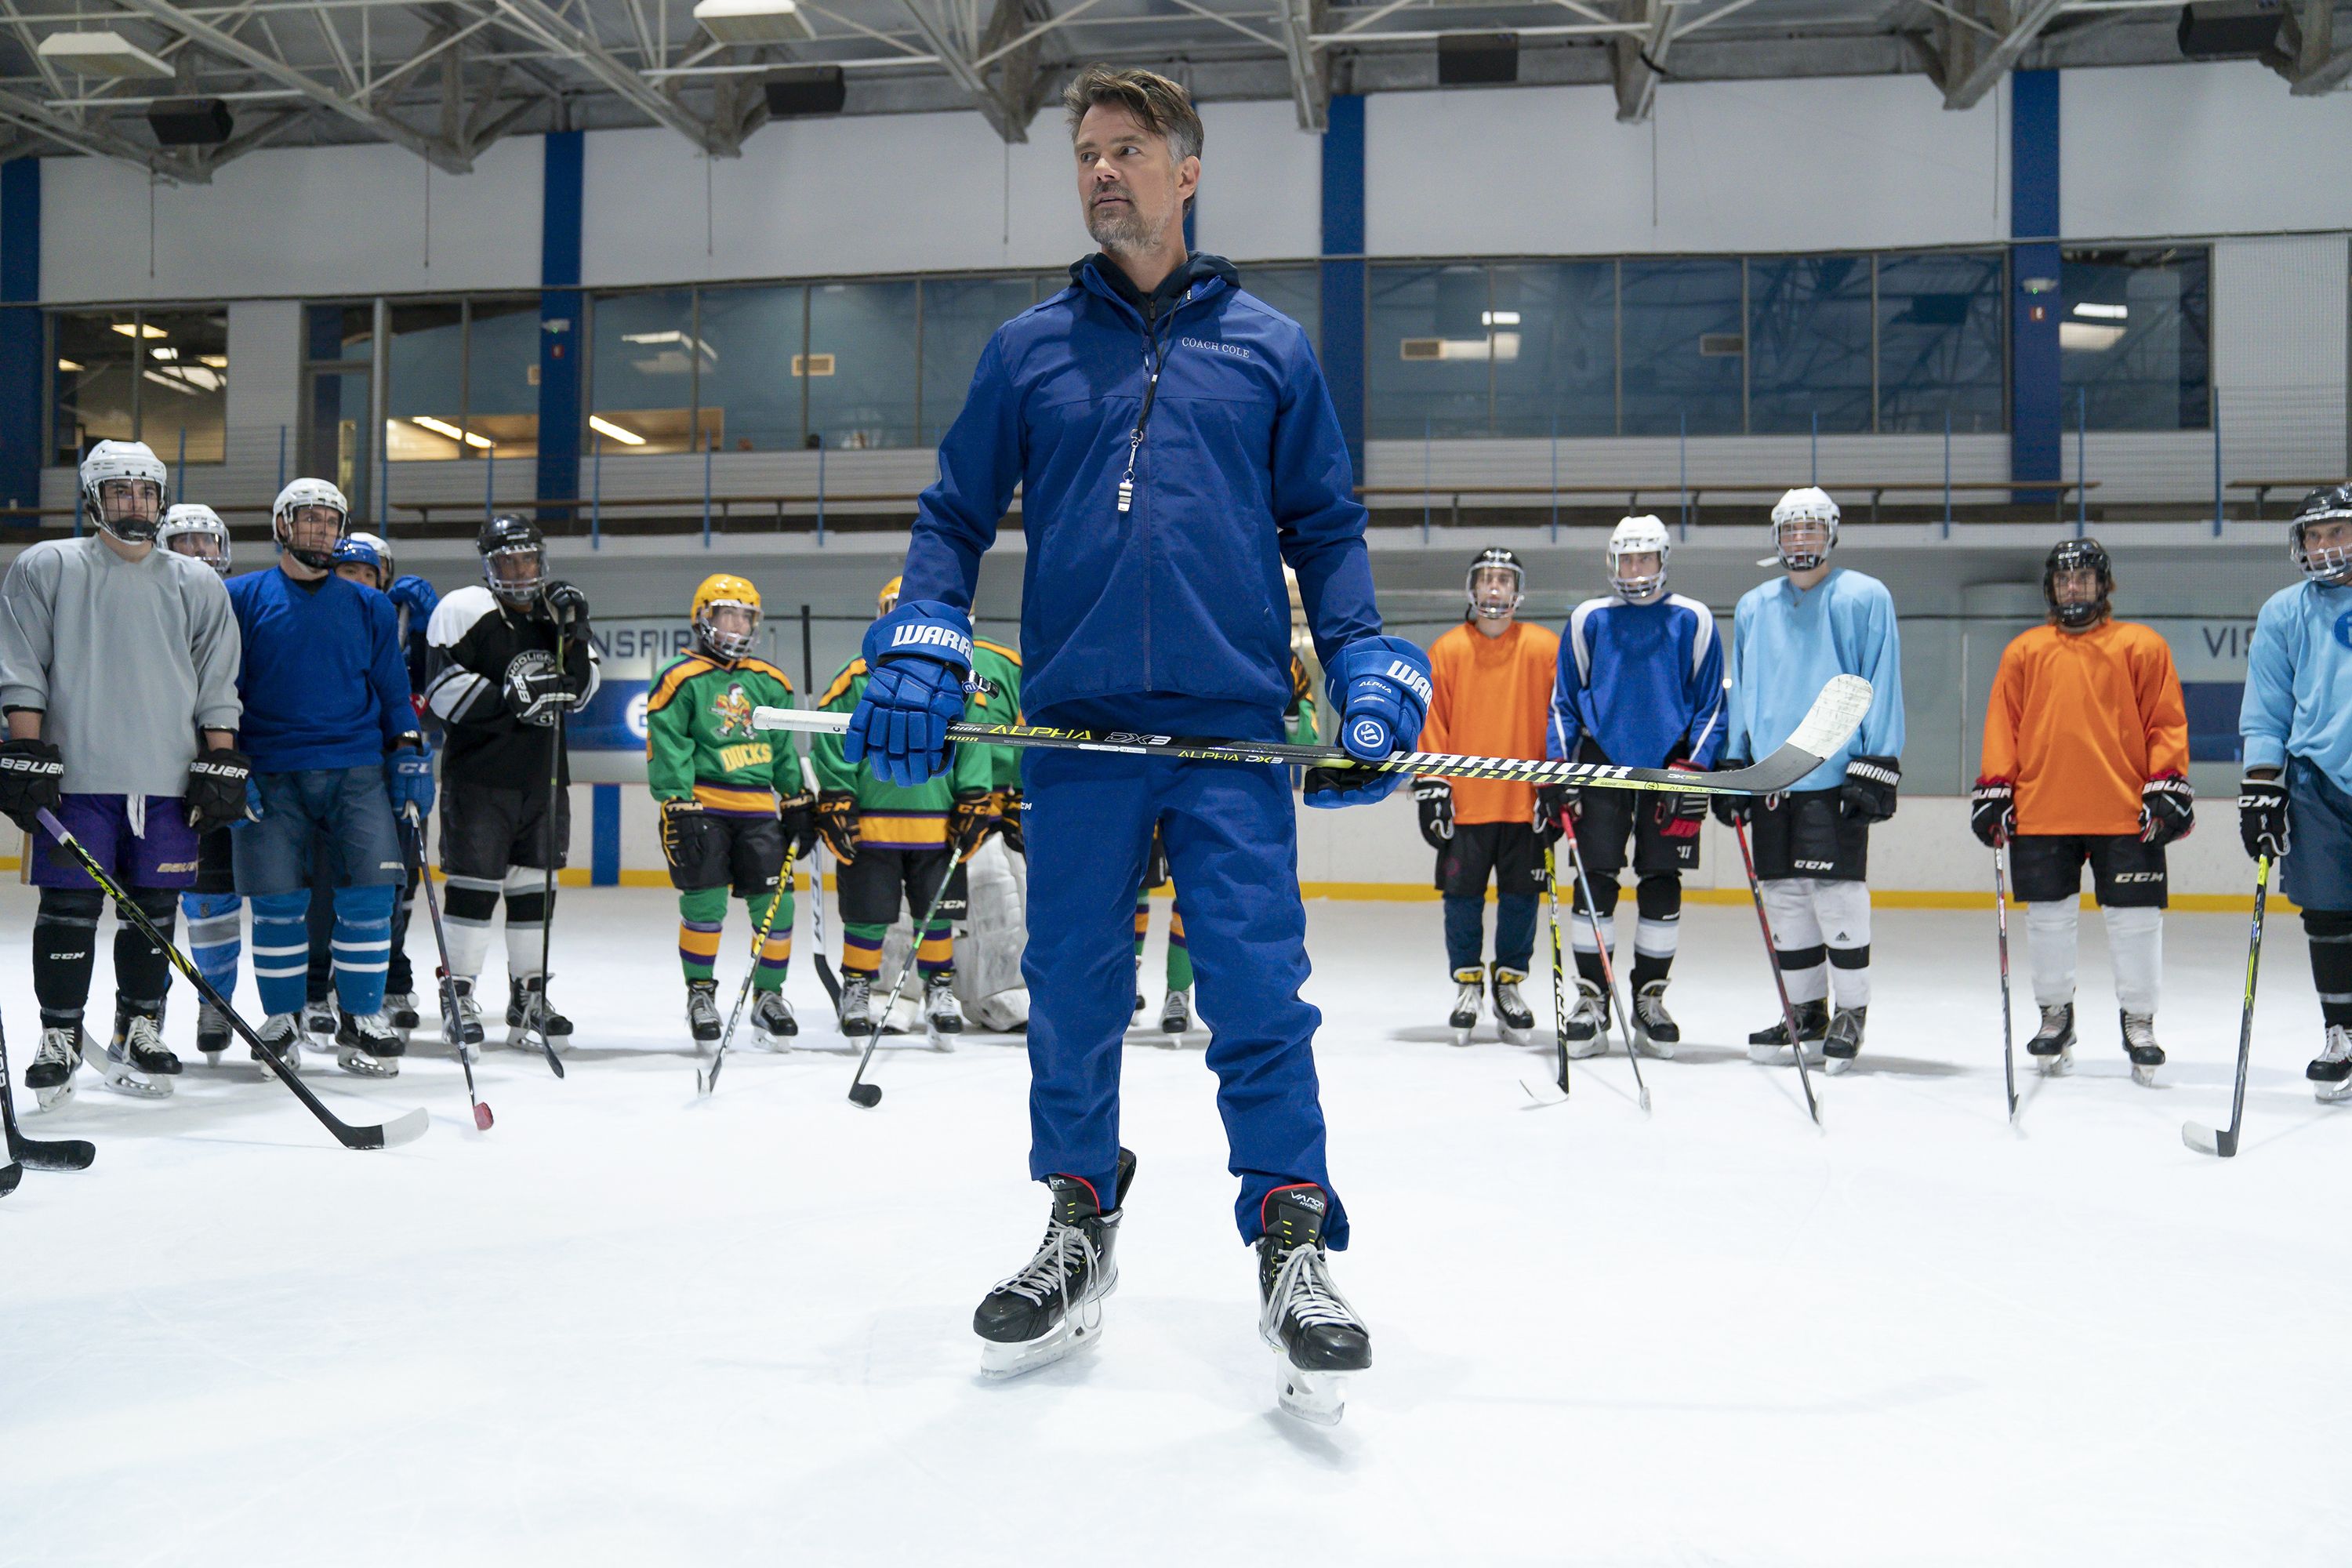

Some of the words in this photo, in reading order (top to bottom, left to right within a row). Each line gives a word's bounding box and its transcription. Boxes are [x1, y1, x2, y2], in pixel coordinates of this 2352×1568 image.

[1181, 337, 1219, 350] COACH
[1221, 343, 1250, 358] COLE
[1359, 681, 1392, 694] ALPHA
[987, 724, 1092, 740] ALPHA
[1104, 731, 1172, 746] DX3
[720, 743, 772, 772] DUCKS
[1178, 750, 1240, 762] ALPHA
[1244, 754, 1284, 764] DX3
[1794, 859, 1835, 871] CCM
[2114, 872, 2164, 884] CCM
[50, 951, 85, 960] CCM
[1290, 1191, 1325, 1210] VAPOR
